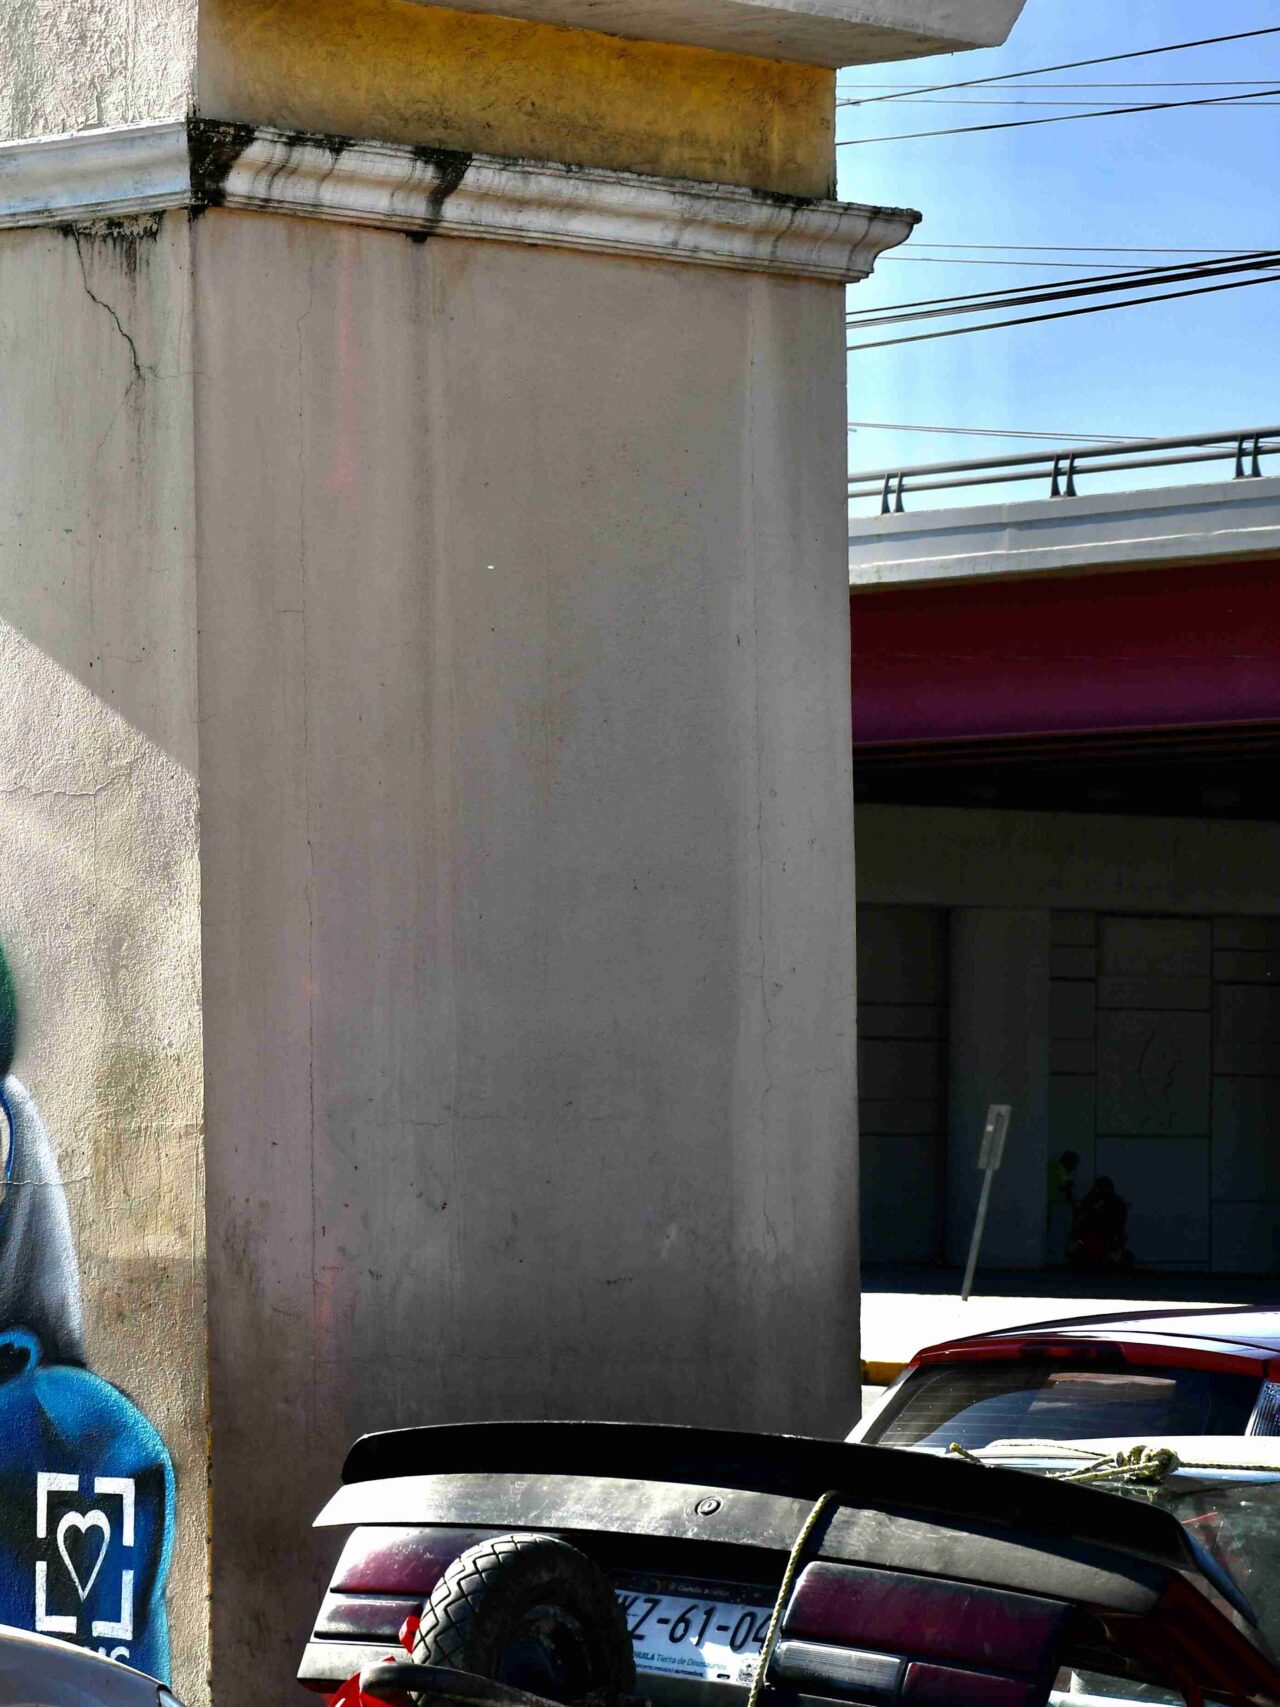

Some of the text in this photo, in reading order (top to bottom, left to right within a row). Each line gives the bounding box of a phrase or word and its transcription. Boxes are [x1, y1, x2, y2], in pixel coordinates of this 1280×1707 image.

[634, 1651, 655, 1660] HUILA
[657, 1654, 677, 1663] Tierra
[677, 1657, 686, 1665] de
